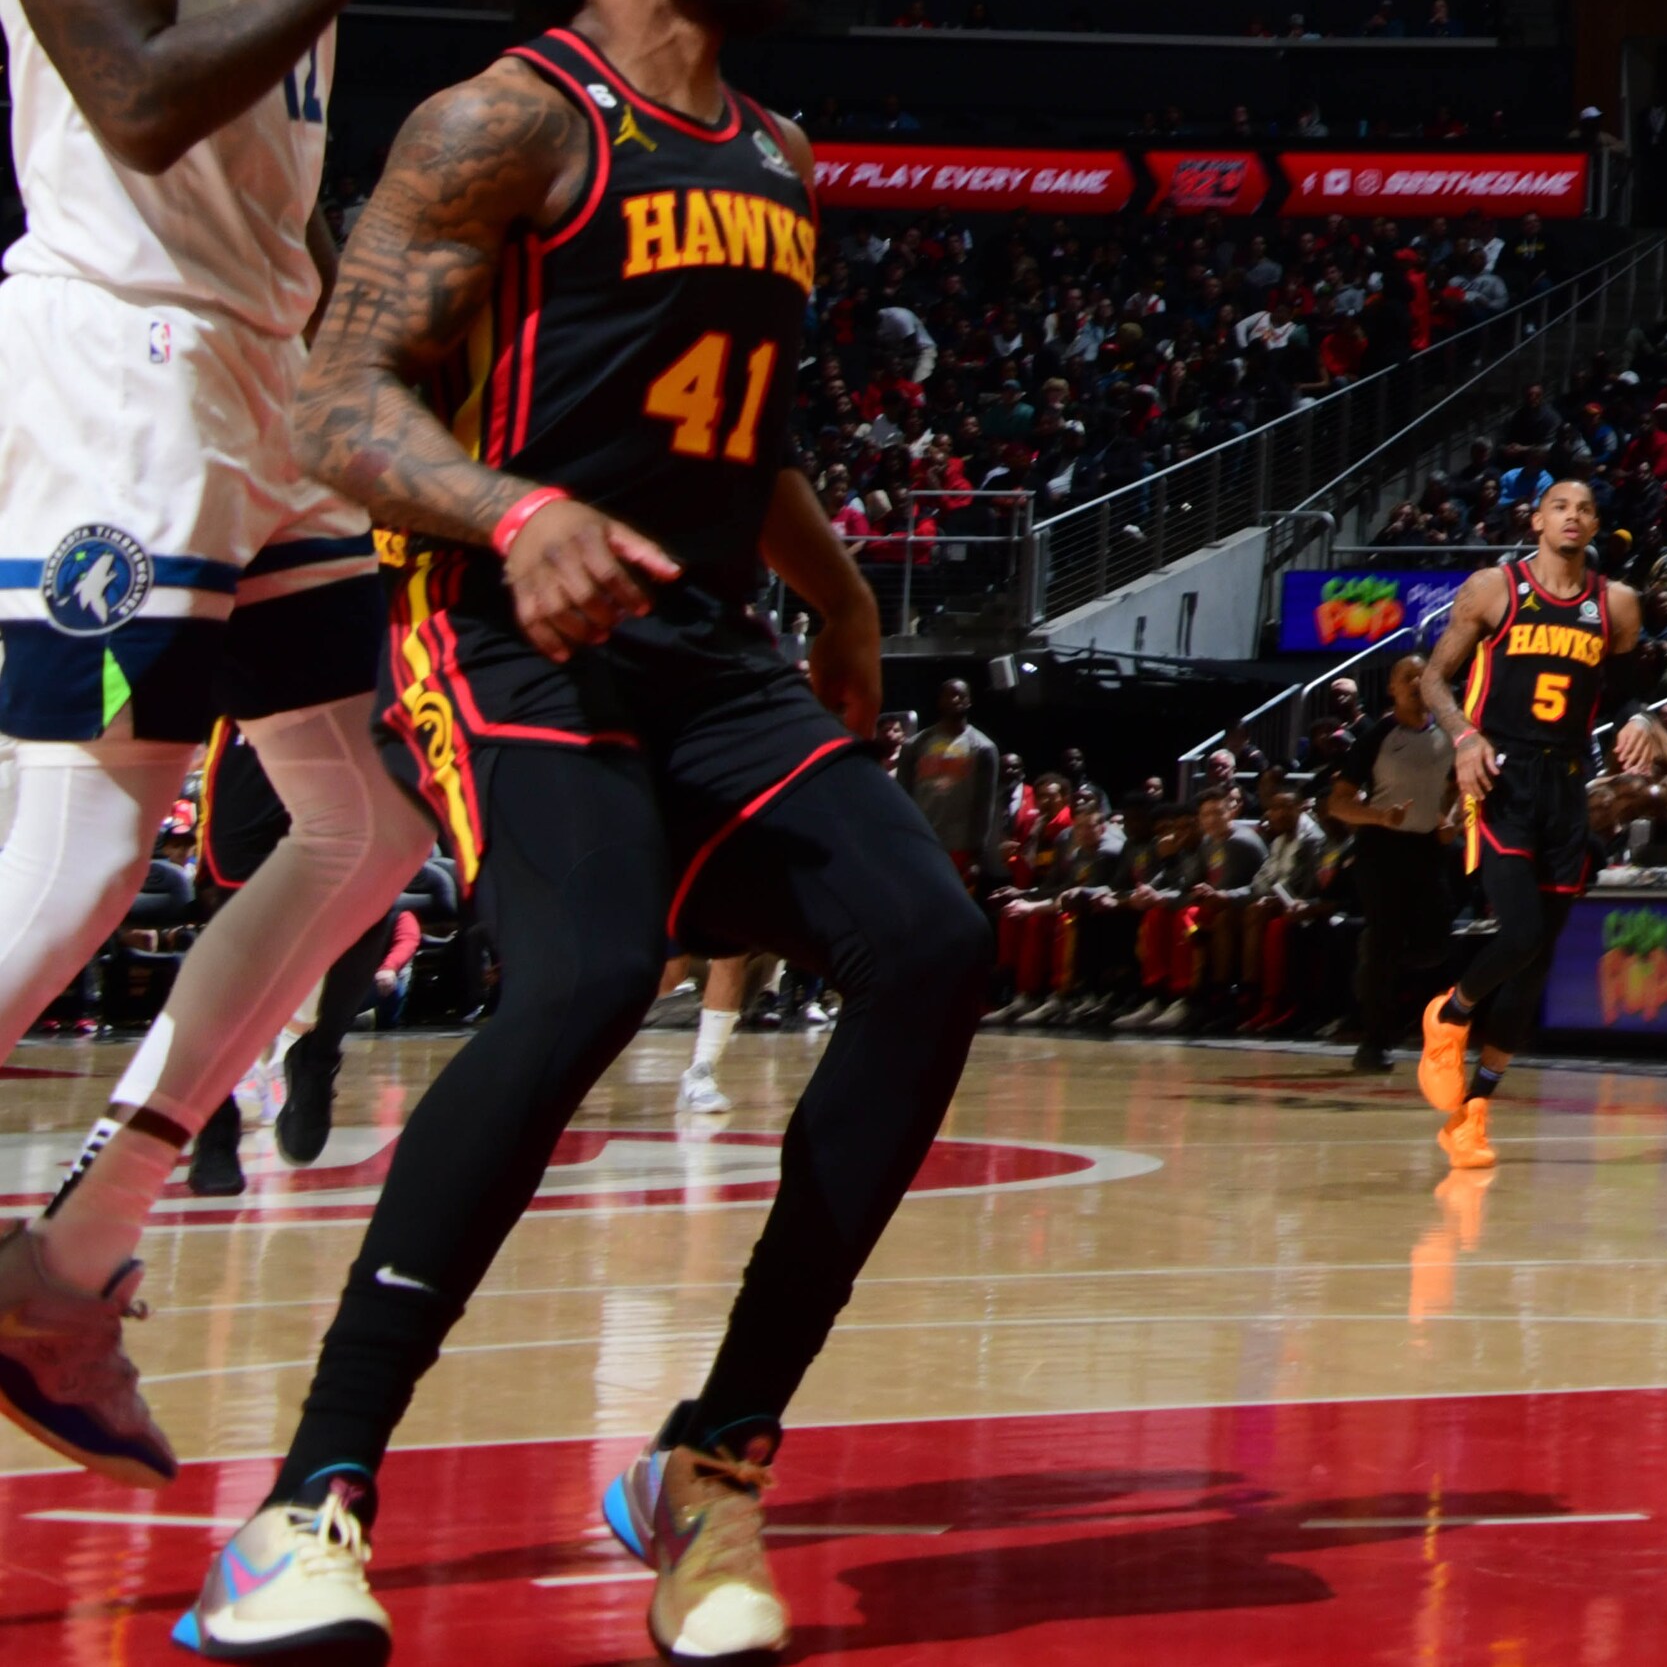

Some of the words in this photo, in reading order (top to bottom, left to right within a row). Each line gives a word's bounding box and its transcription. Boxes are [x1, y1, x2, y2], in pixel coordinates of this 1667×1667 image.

[621, 188, 816, 296] HAWKS
[641, 331, 777, 465] 41
[1507, 623, 1604, 668] HAWKS
[1531, 672, 1573, 723] 5
